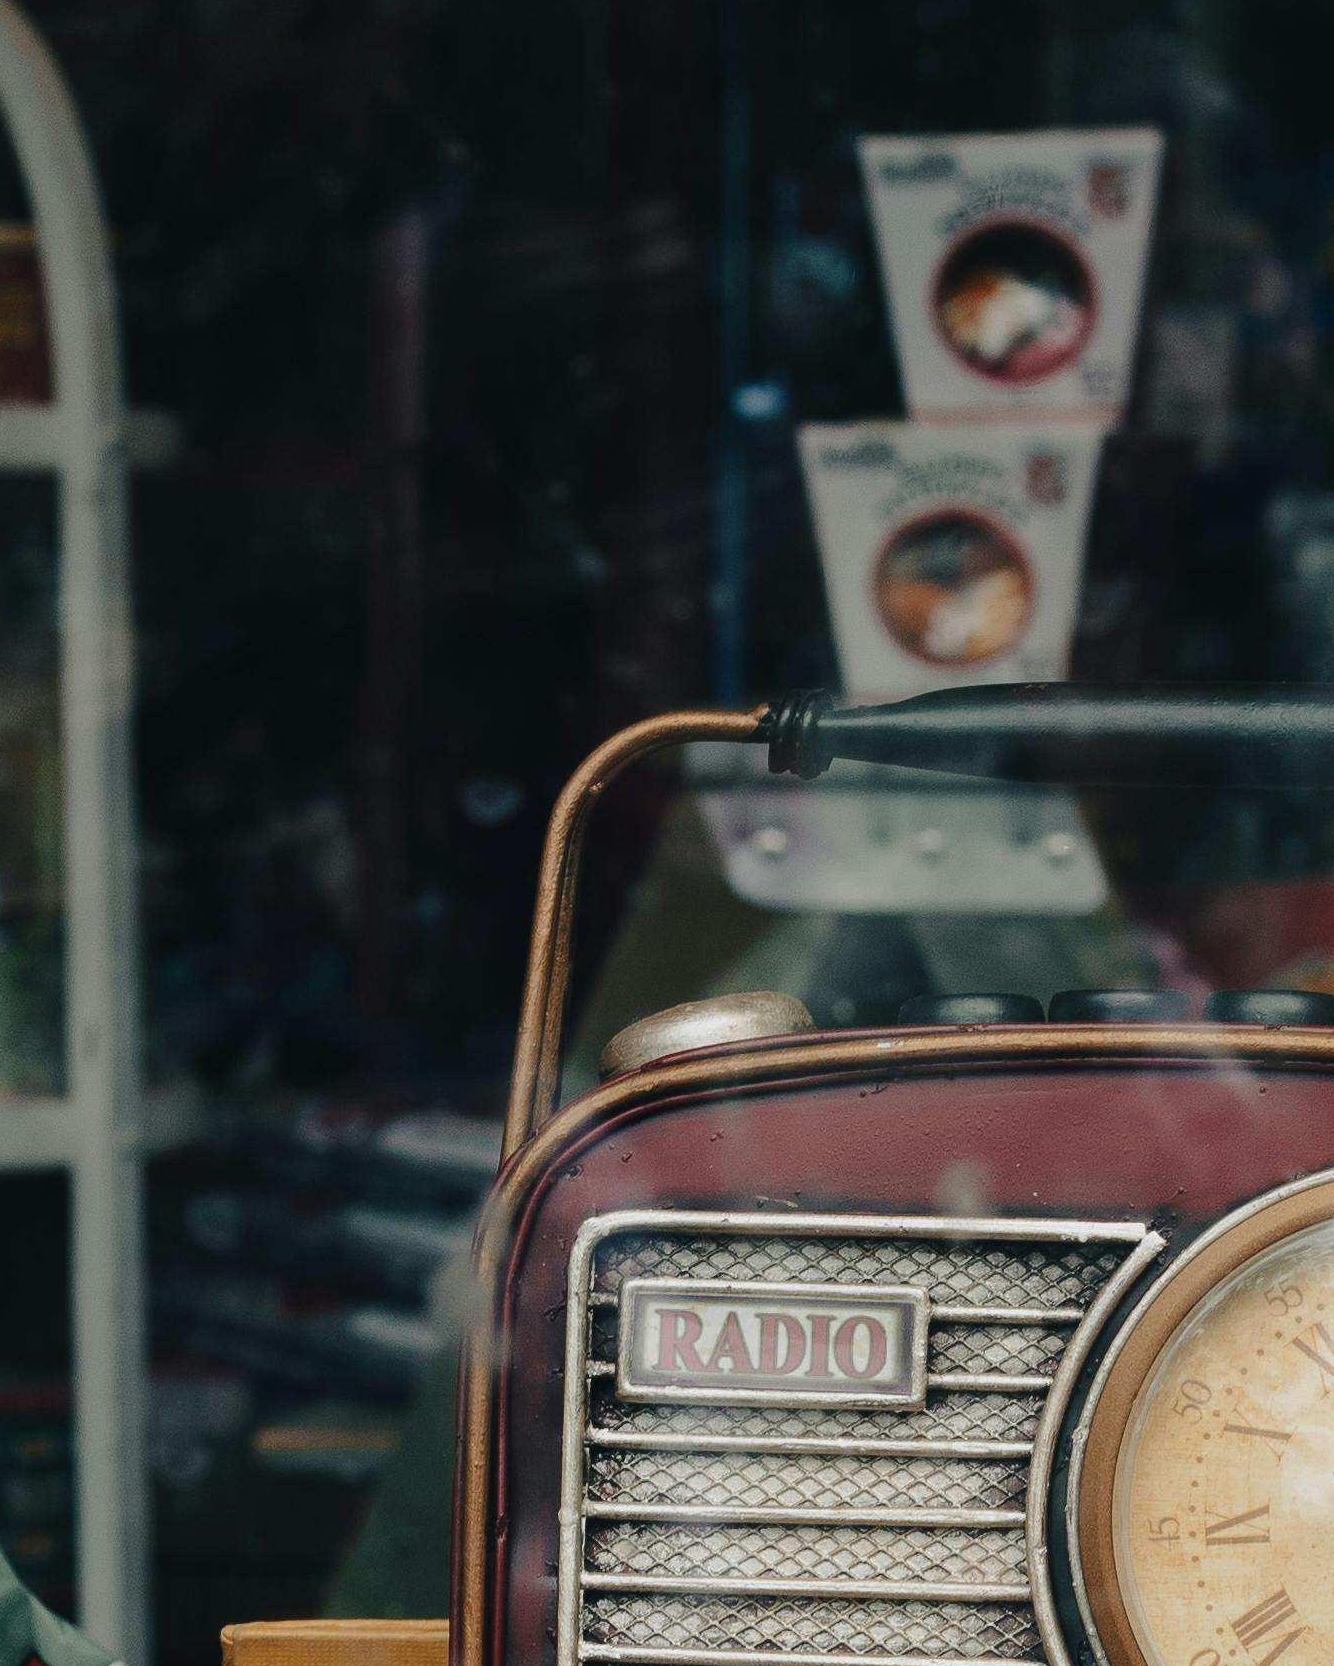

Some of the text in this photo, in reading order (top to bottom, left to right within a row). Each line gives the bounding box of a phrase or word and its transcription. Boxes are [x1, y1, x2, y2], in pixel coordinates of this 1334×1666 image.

[1264, 1282, 1305, 1318] 55
[652, 1308, 889, 1379] RADIO
[1173, 1378, 1213, 1423] 50
[1222, 1402, 1293, 1462] X
[1148, 1516, 1181, 1543] 45
[1204, 1503, 1271, 1547] IX
